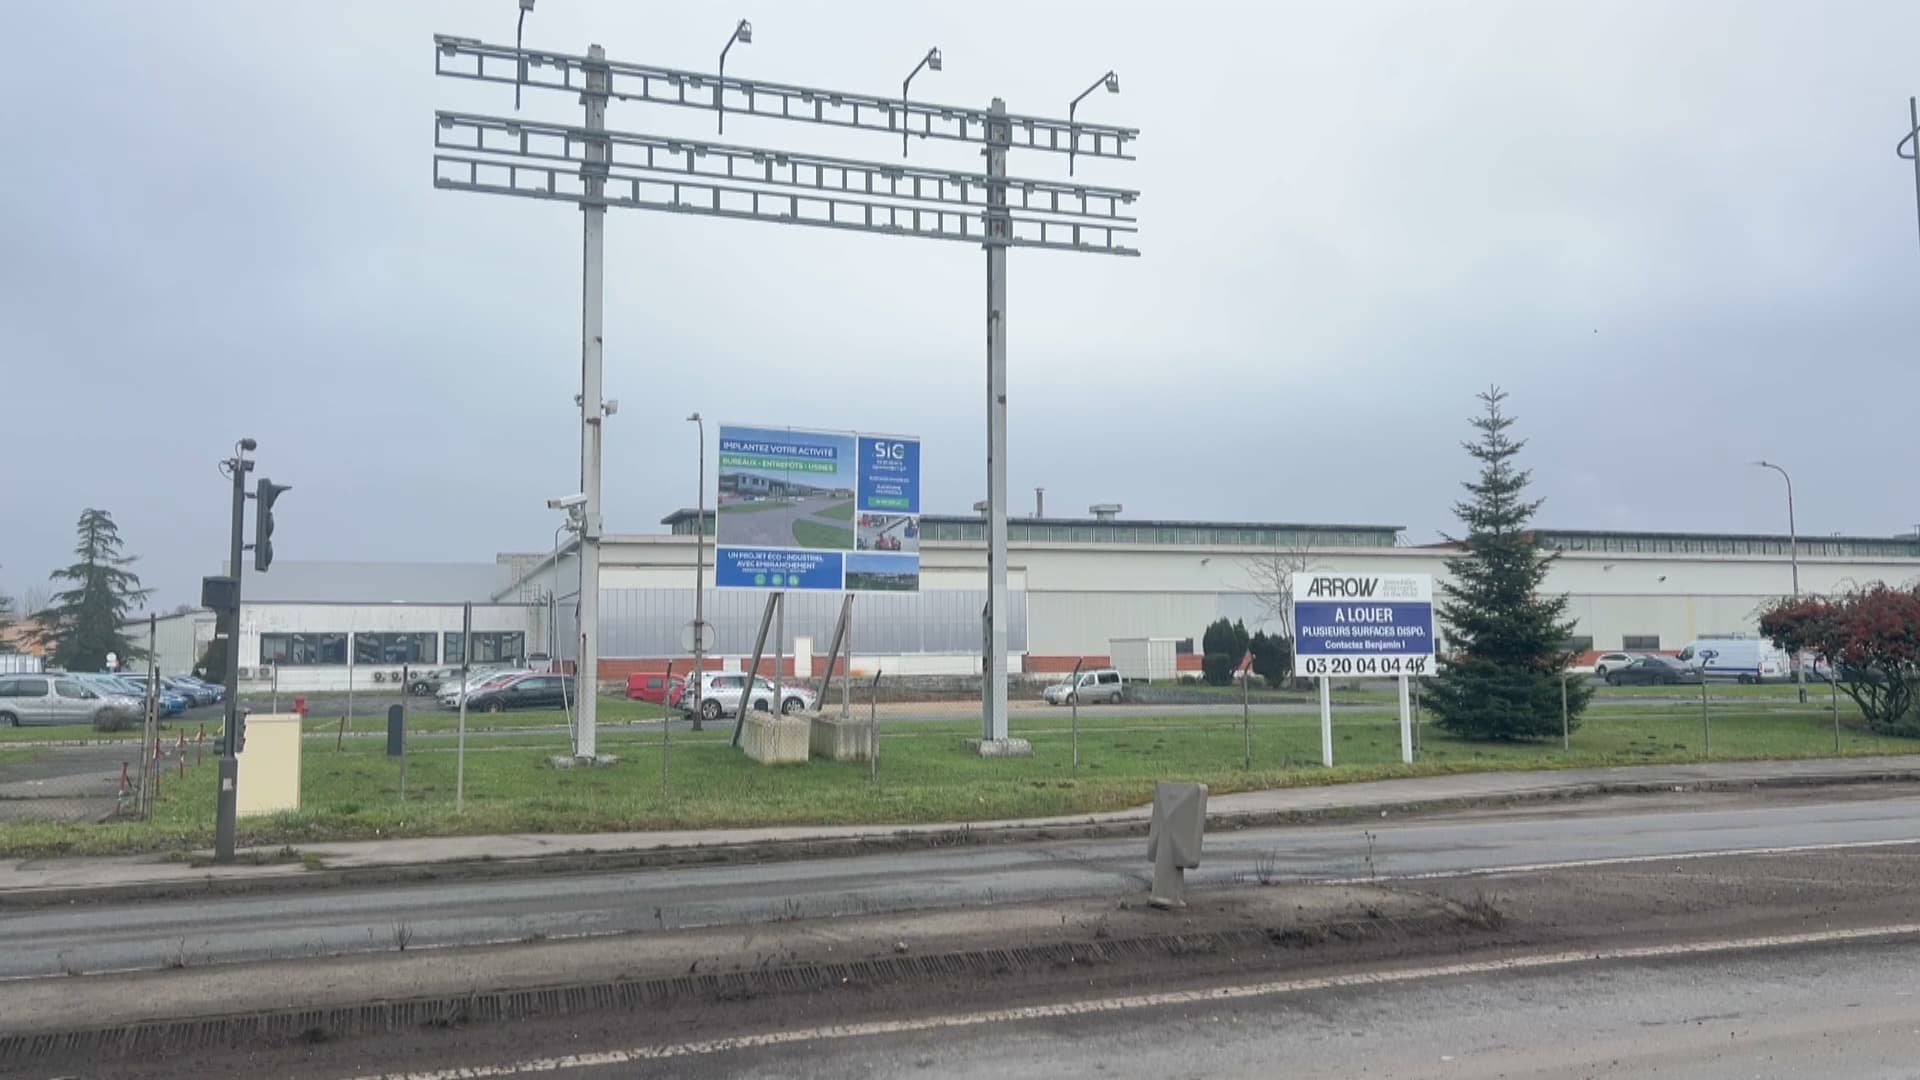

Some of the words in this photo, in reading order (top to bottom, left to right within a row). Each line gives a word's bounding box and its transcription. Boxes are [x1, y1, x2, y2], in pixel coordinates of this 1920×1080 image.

[723, 441, 769, 453] IMPLANTEZ
[770, 445, 797, 455] VOTRE
[722, 457, 757, 467] BUREAUX
[808, 462, 833, 472] USINES
[727, 551, 738, 559] UN
[739, 551, 767, 560] PROJET
[736, 560, 755, 568] AVEC
[1307, 577, 1379, 597] ARROW
[1335, 607, 1345, 622] A
[1348, 607, 1393, 622] LOUER
[1302, 625, 1350, 637] PLUSIEURS
[1351, 625, 1396, 637] SURFACES
[1364, 639, 1401, 652] Benjamin
[1306, 657, 1327, 673] 03
[1331, 657, 1352, 673] 20
[1356, 657, 1376, 673] 04
[1381, 657, 1401, 673] 04
